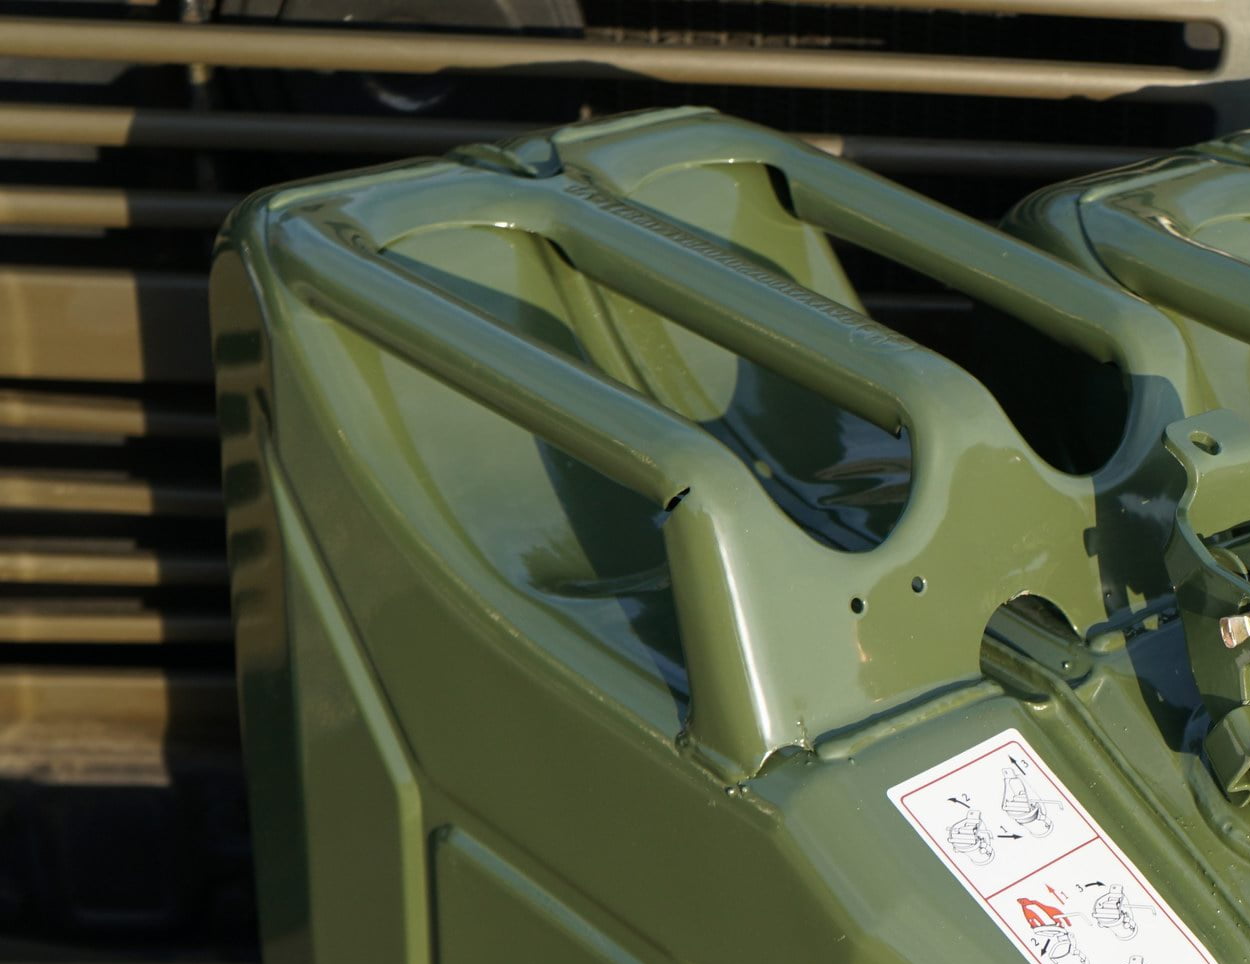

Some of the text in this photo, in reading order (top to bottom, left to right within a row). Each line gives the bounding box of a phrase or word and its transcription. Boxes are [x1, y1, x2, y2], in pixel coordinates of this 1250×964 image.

[1021, 759, 1029, 768] 3
[962, 793, 971, 802] 2
[1000, 825, 1008, 833] 1
[1075, 884, 1084, 893] 3
[1060, 890, 1069, 900] 1
[1030, 937, 1040, 947] 2
